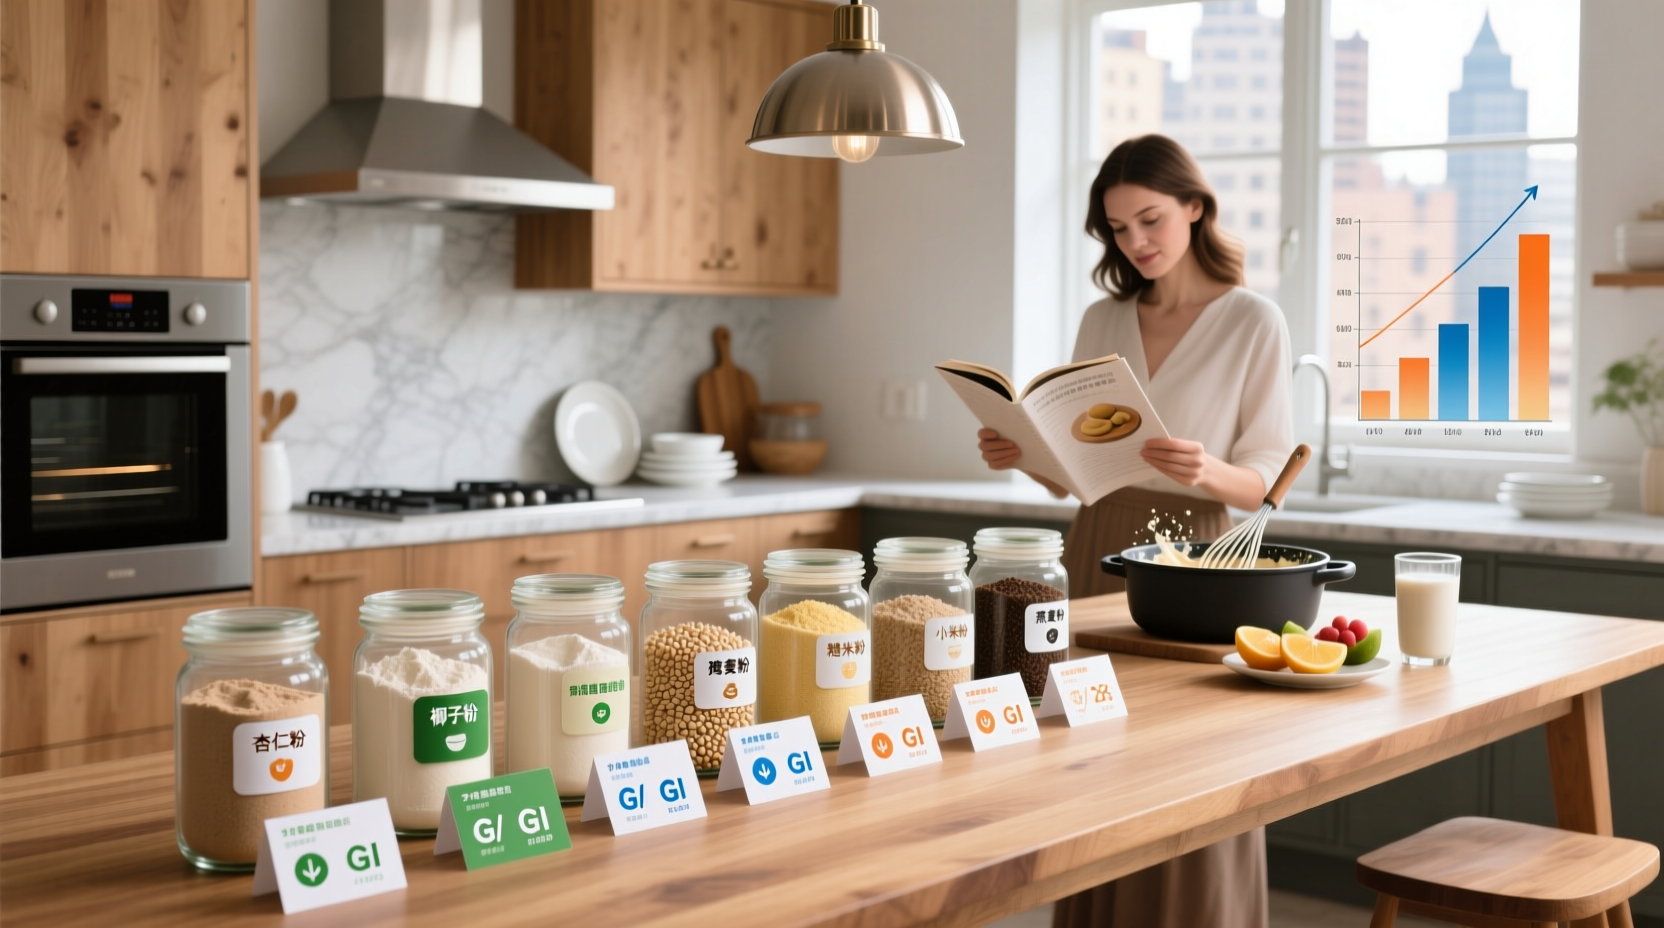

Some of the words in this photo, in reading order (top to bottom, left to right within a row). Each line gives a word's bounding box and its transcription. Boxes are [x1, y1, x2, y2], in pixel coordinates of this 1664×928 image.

[1003, 704, 1024, 725] GI
[252, 729, 306, 753] 杏仁粉
[901, 726, 925, 748] GI
[787, 751, 813, 774] GI
[659, 777, 687, 802] GI
[518, 806, 550, 834] GI
[346, 842, 381, 871] GI
